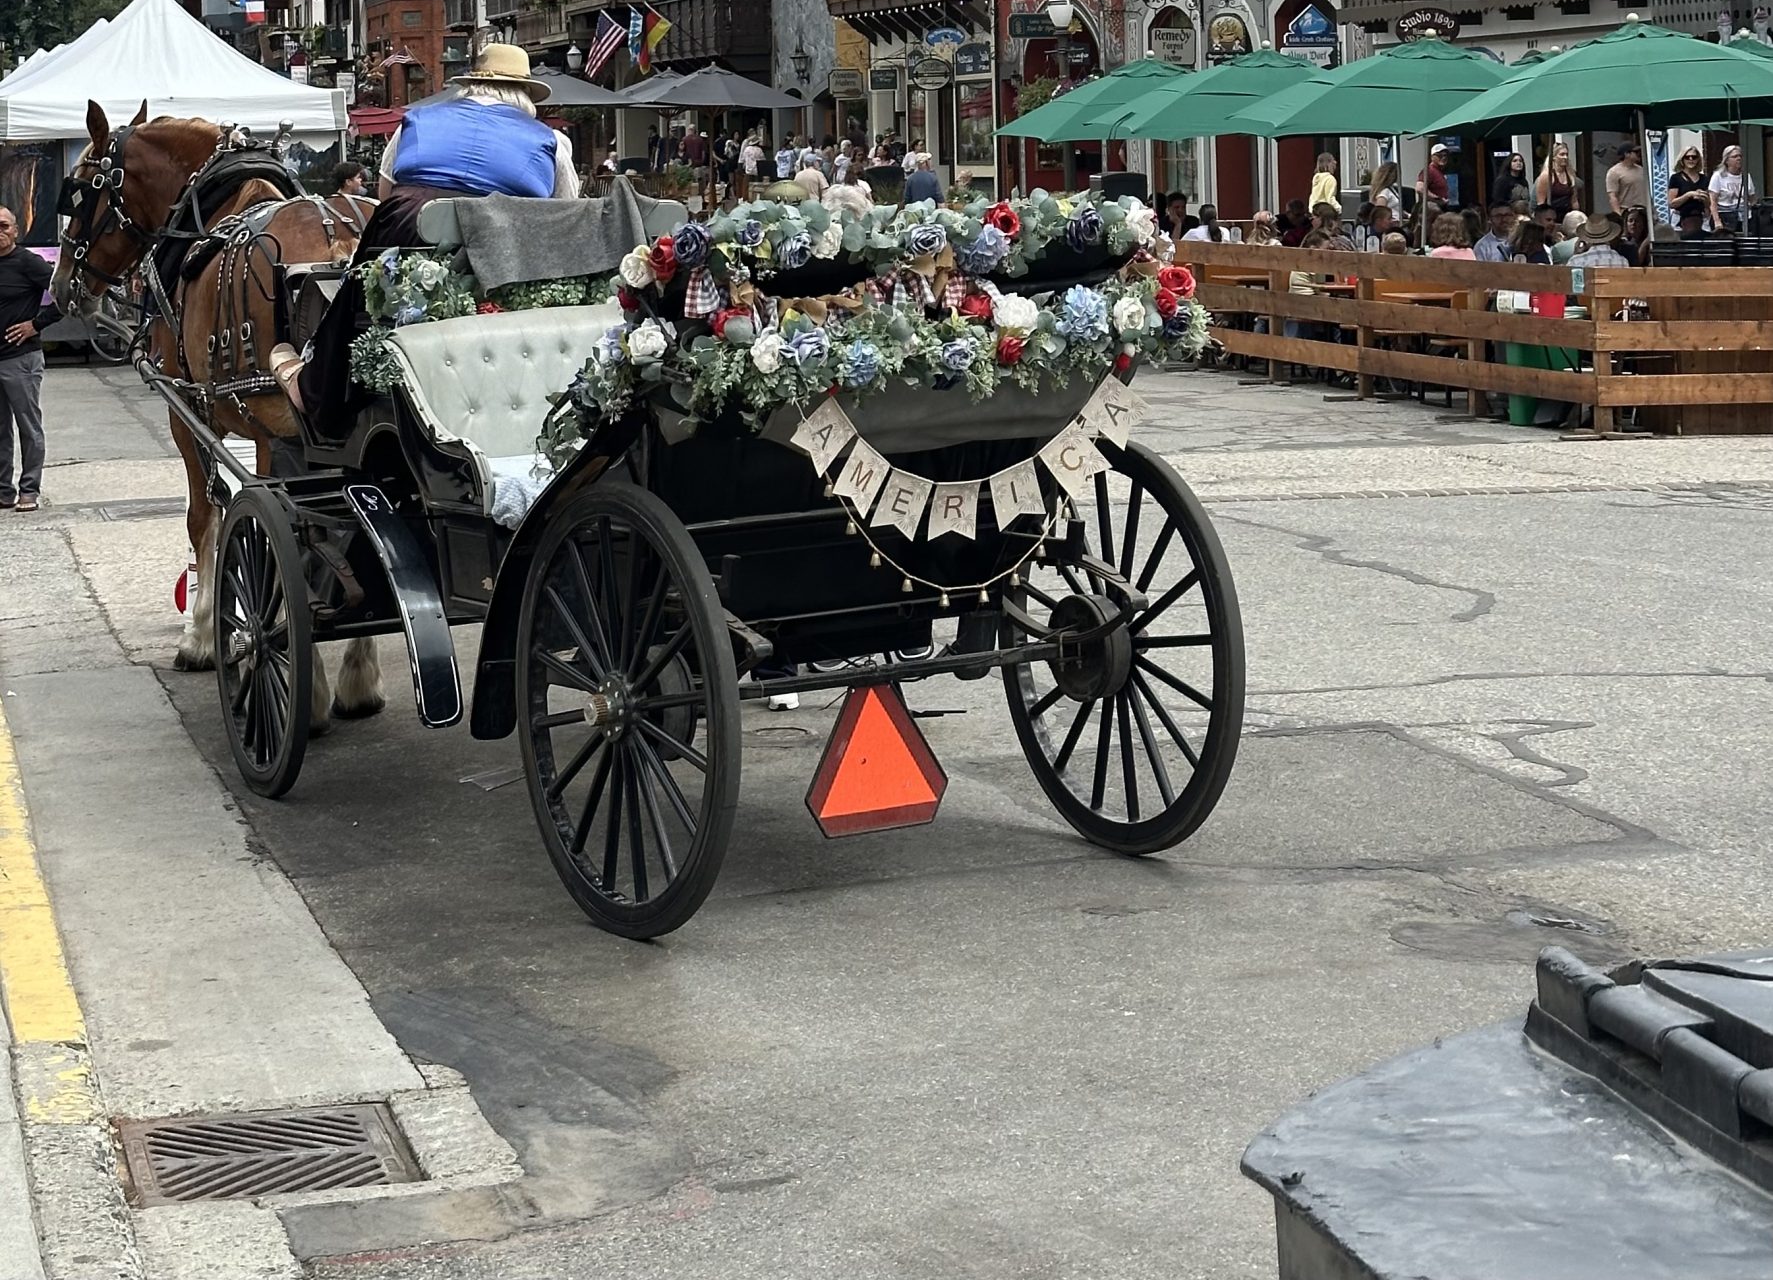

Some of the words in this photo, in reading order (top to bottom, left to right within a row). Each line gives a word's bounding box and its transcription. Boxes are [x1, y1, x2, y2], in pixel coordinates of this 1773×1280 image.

[1400, 10, 1431, 32] Studio
[1434, 12, 1455, 29] 1890
[1154, 29, 1191, 44] Remedy
